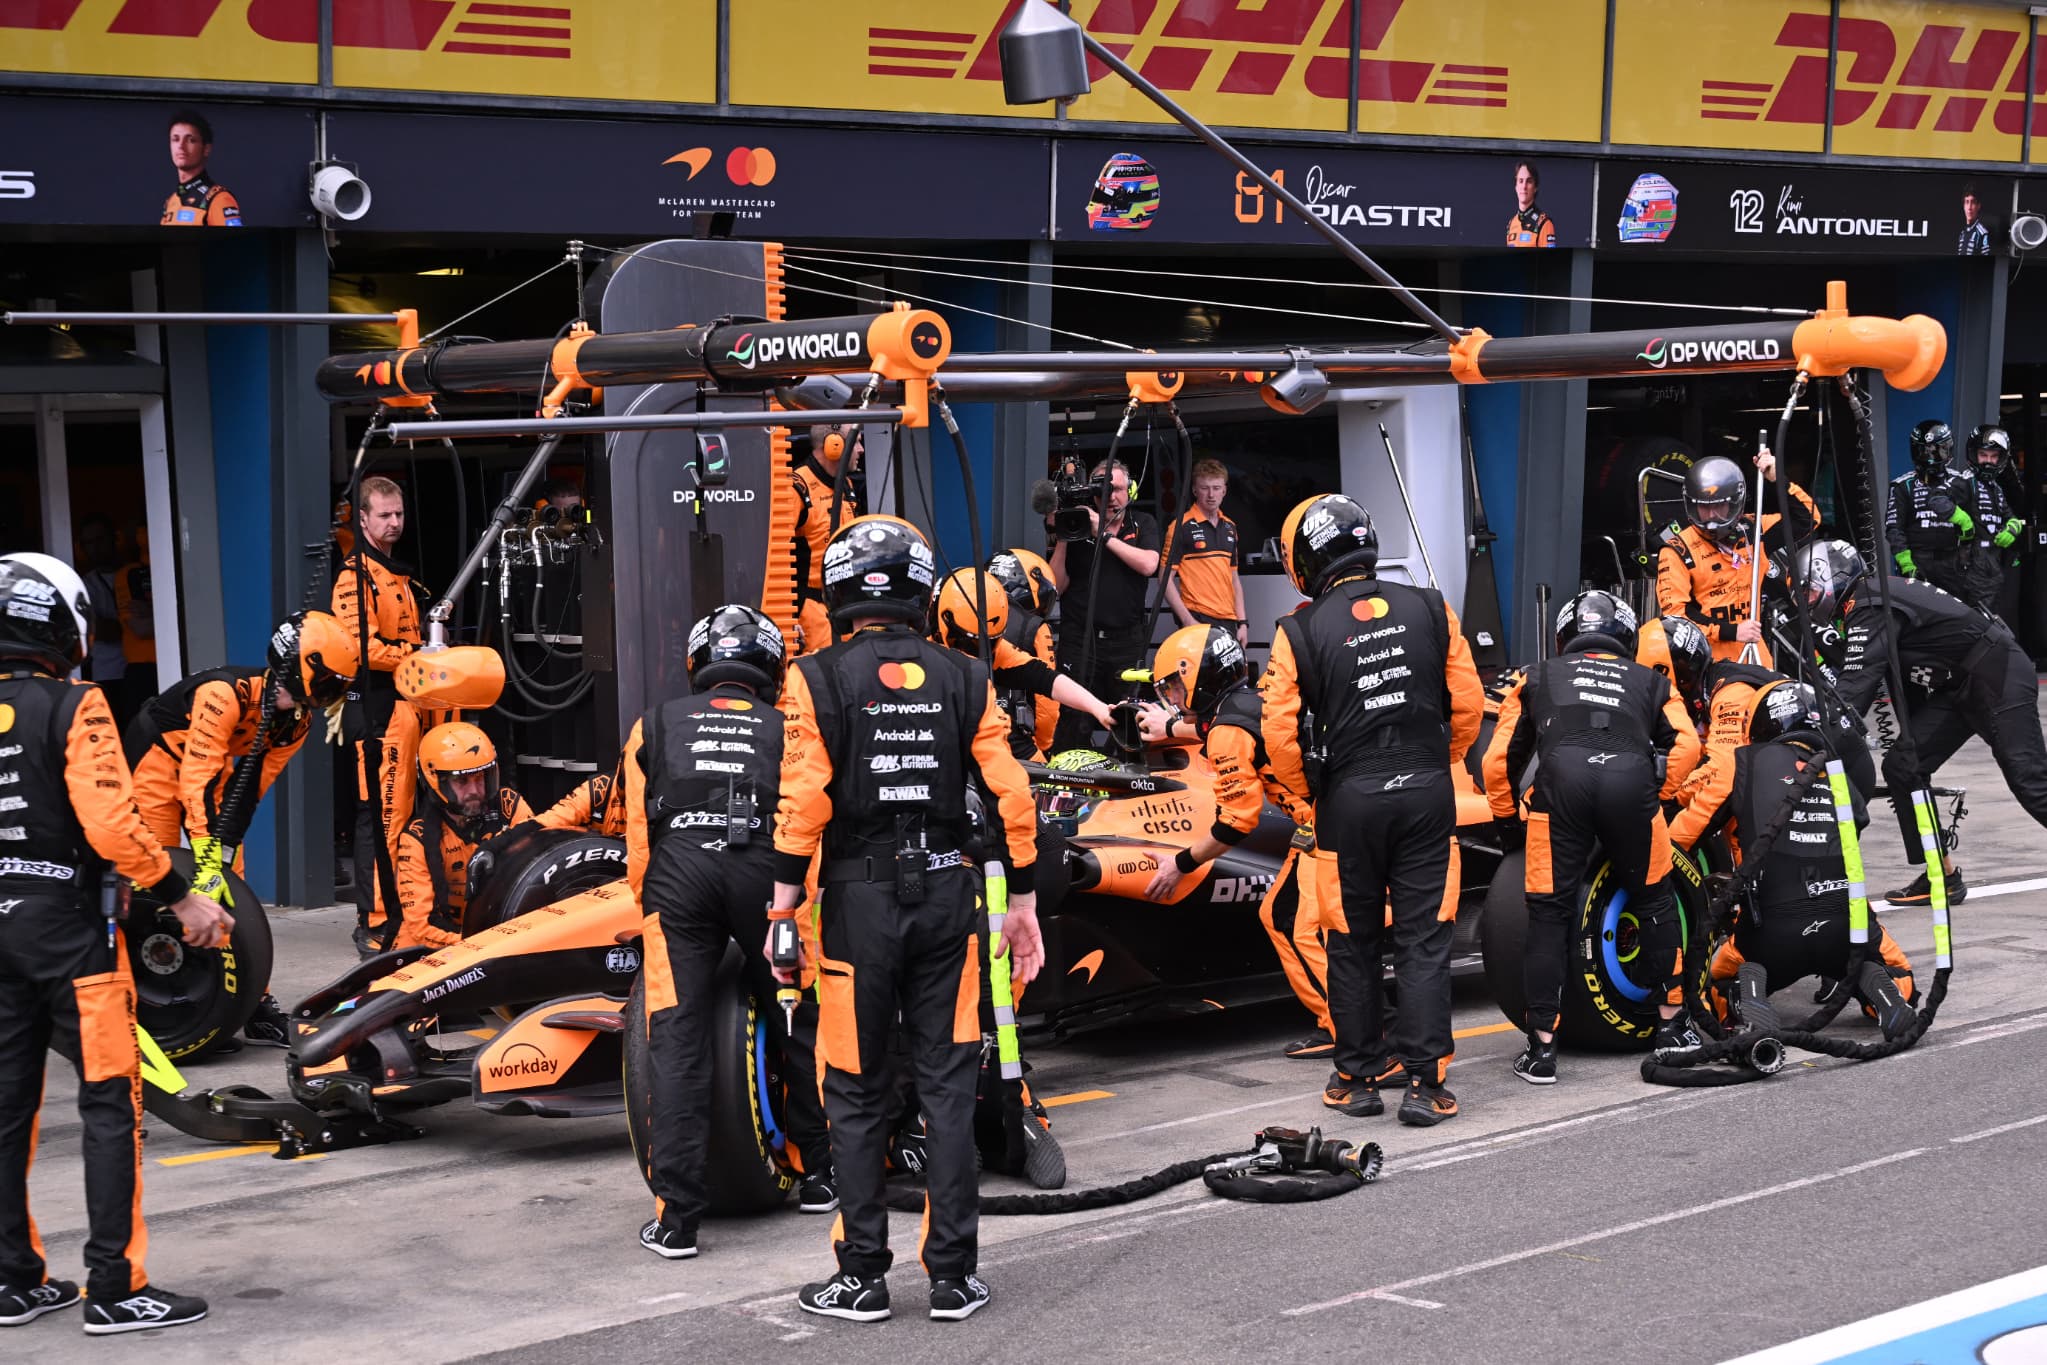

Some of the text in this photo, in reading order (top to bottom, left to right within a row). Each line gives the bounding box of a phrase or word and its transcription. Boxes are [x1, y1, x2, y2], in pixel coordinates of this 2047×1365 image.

[711, 199, 776, 208] MASTERCARD
[1235, 165, 1356, 224] 81 Oscar
[1305, 204, 1451, 228] PIASTRI
[1730, 184, 1803, 233] 12 Kimi
[1776, 217, 1928, 237] ANTONELLI
[758, 332, 861, 362] DP WORLD
[1671, 338, 1779, 363] DP WORLD
[1671, 452, 1695, 468] ZER
[673, 489, 755, 503] DP WORLD
[1358, 625, 1406, 643] DP WORLD
[1357, 648, 1391, 666] Android
[1357, 672, 1384, 692] ON
[882, 703, 942, 714] DP WORLD
[697, 725, 736, 735] Android
[786, 729, 800, 740] ta
[874, 728, 916, 741] Android
[870, 754, 902, 773] ON
[902, 755, 934, 763] OPTIMUM
[902, 761, 939, 769] NUTRITION
[385, 767, 398, 806] OPTIMUM
[1130, 779, 1155, 791] okta
[382, 808, 394, 843] NUTRI
[1143, 819, 1193, 835] CISCO
[543, 863, 558, 885] P
[1671, 852, 1701, 888] IRELLI
[608, 953, 639, 973] FIA
[422, 967, 487, 1004] JACK DANIEL'S
[1584, 973, 1655, 1038] P ZERO
[489, 1055, 559, 1079] workday
